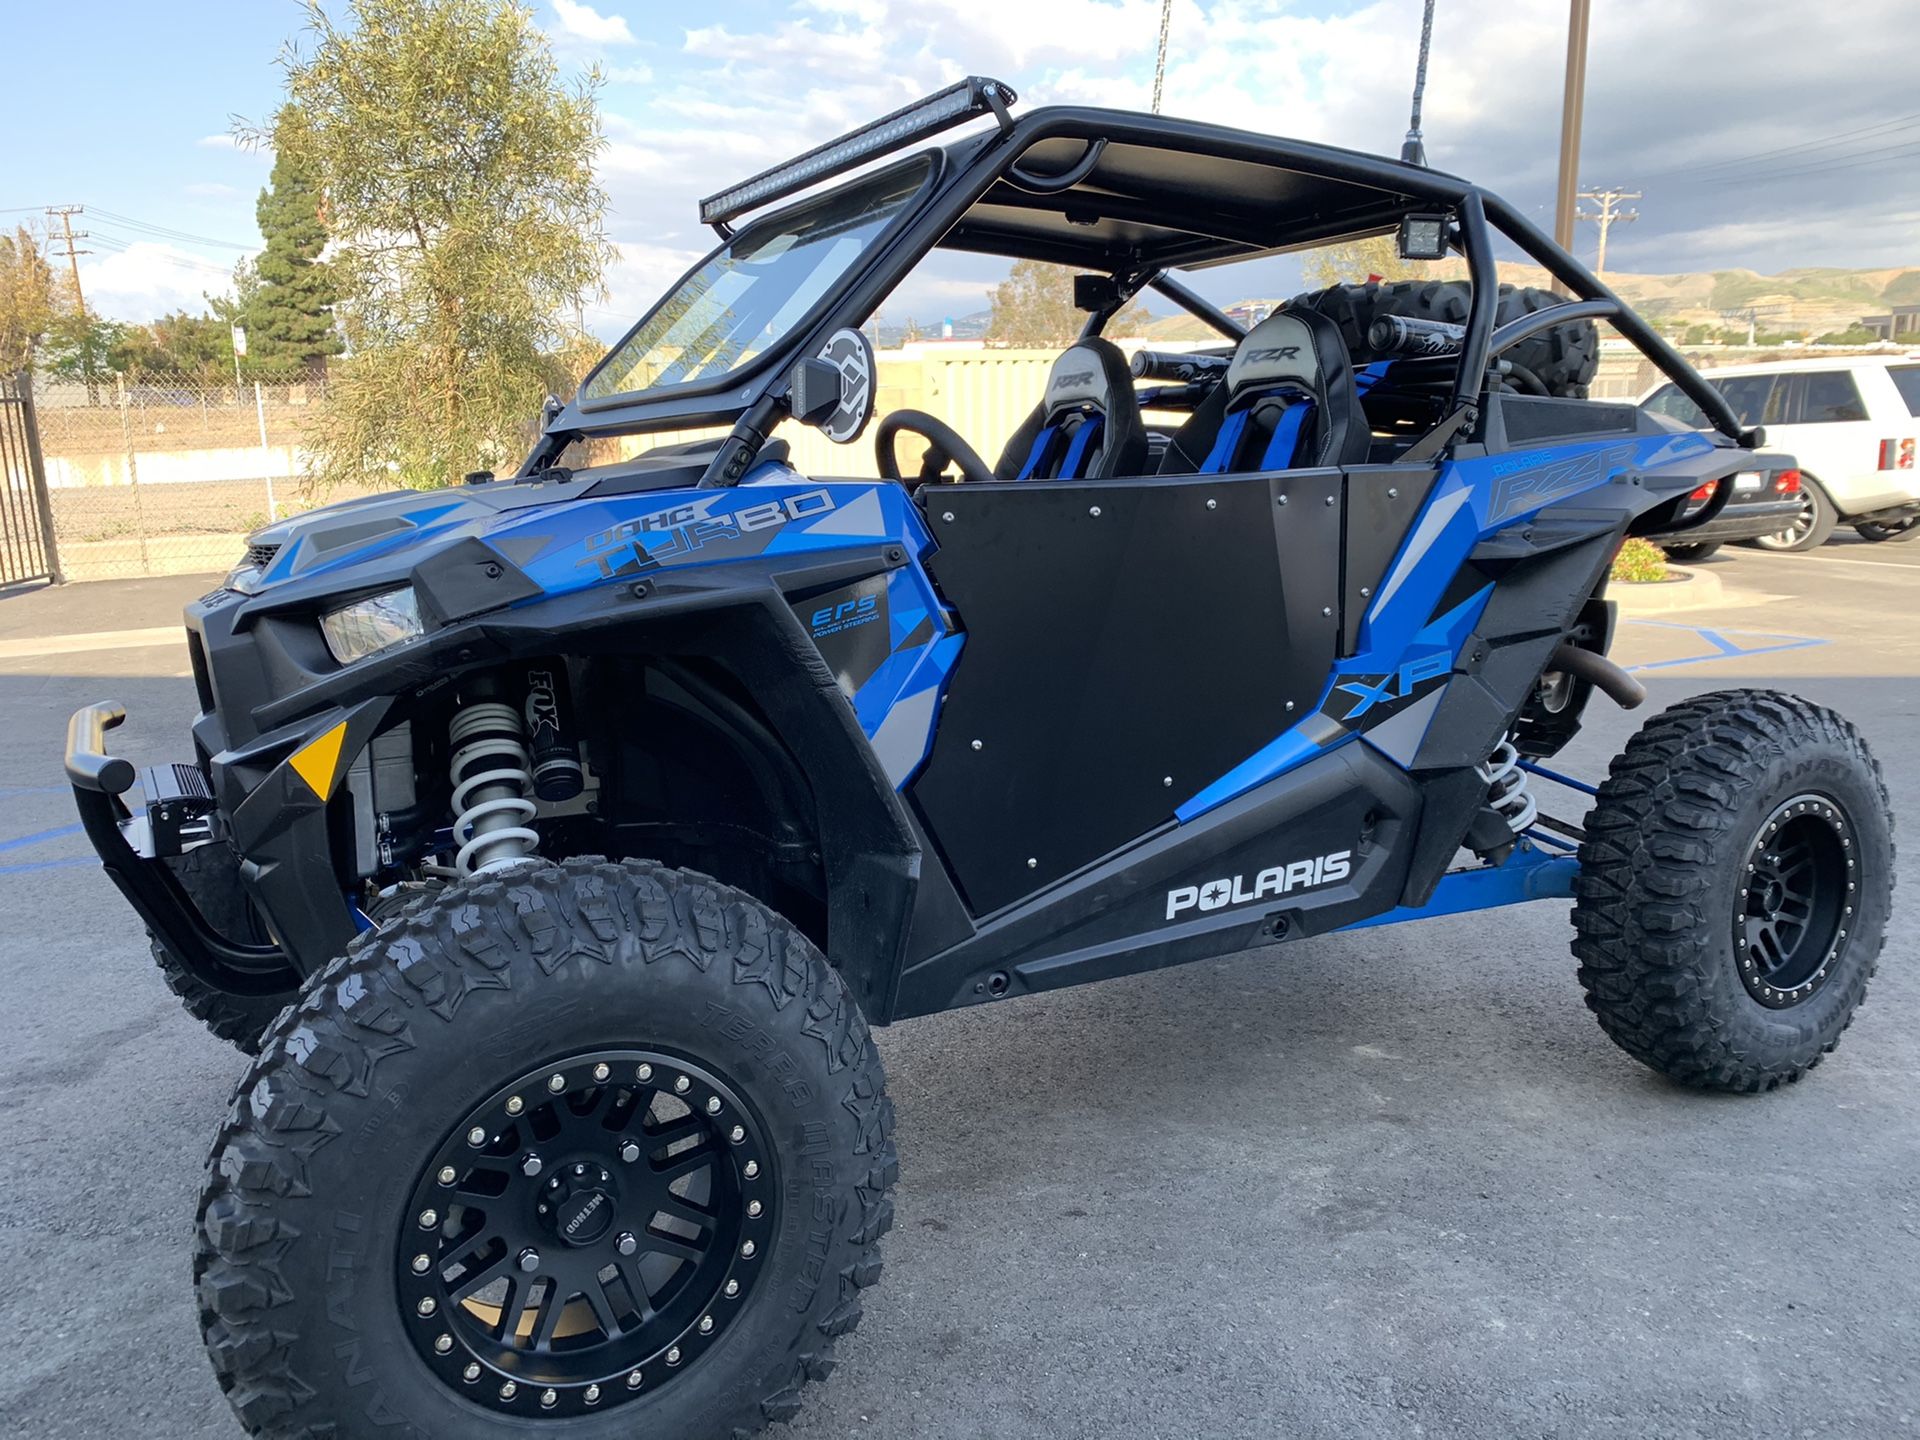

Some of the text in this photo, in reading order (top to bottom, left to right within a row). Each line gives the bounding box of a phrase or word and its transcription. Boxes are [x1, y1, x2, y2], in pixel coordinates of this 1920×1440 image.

[1051, 371, 1095, 392] RZR
[1238, 346, 1300, 368] RZR
[1487, 441, 1641, 525] RZR
[1492, 452, 1554, 477] POLARIS
[574, 487, 838, 580] TURBO
[585, 504, 695, 552] DOHC
[811, 594, 877, 627] EPS
[812, 613, 880, 639] POWER STEERING
[525, 670, 560, 738] FOX
[1334, 649, 1453, 722] XP
[1165, 849, 1352, 921] POLARIS
[700, 1000, 814, 1109] TERRA
[565, 1193, 605, 1234] METHOD
[789, 1120, 837, 1314] MASTER
